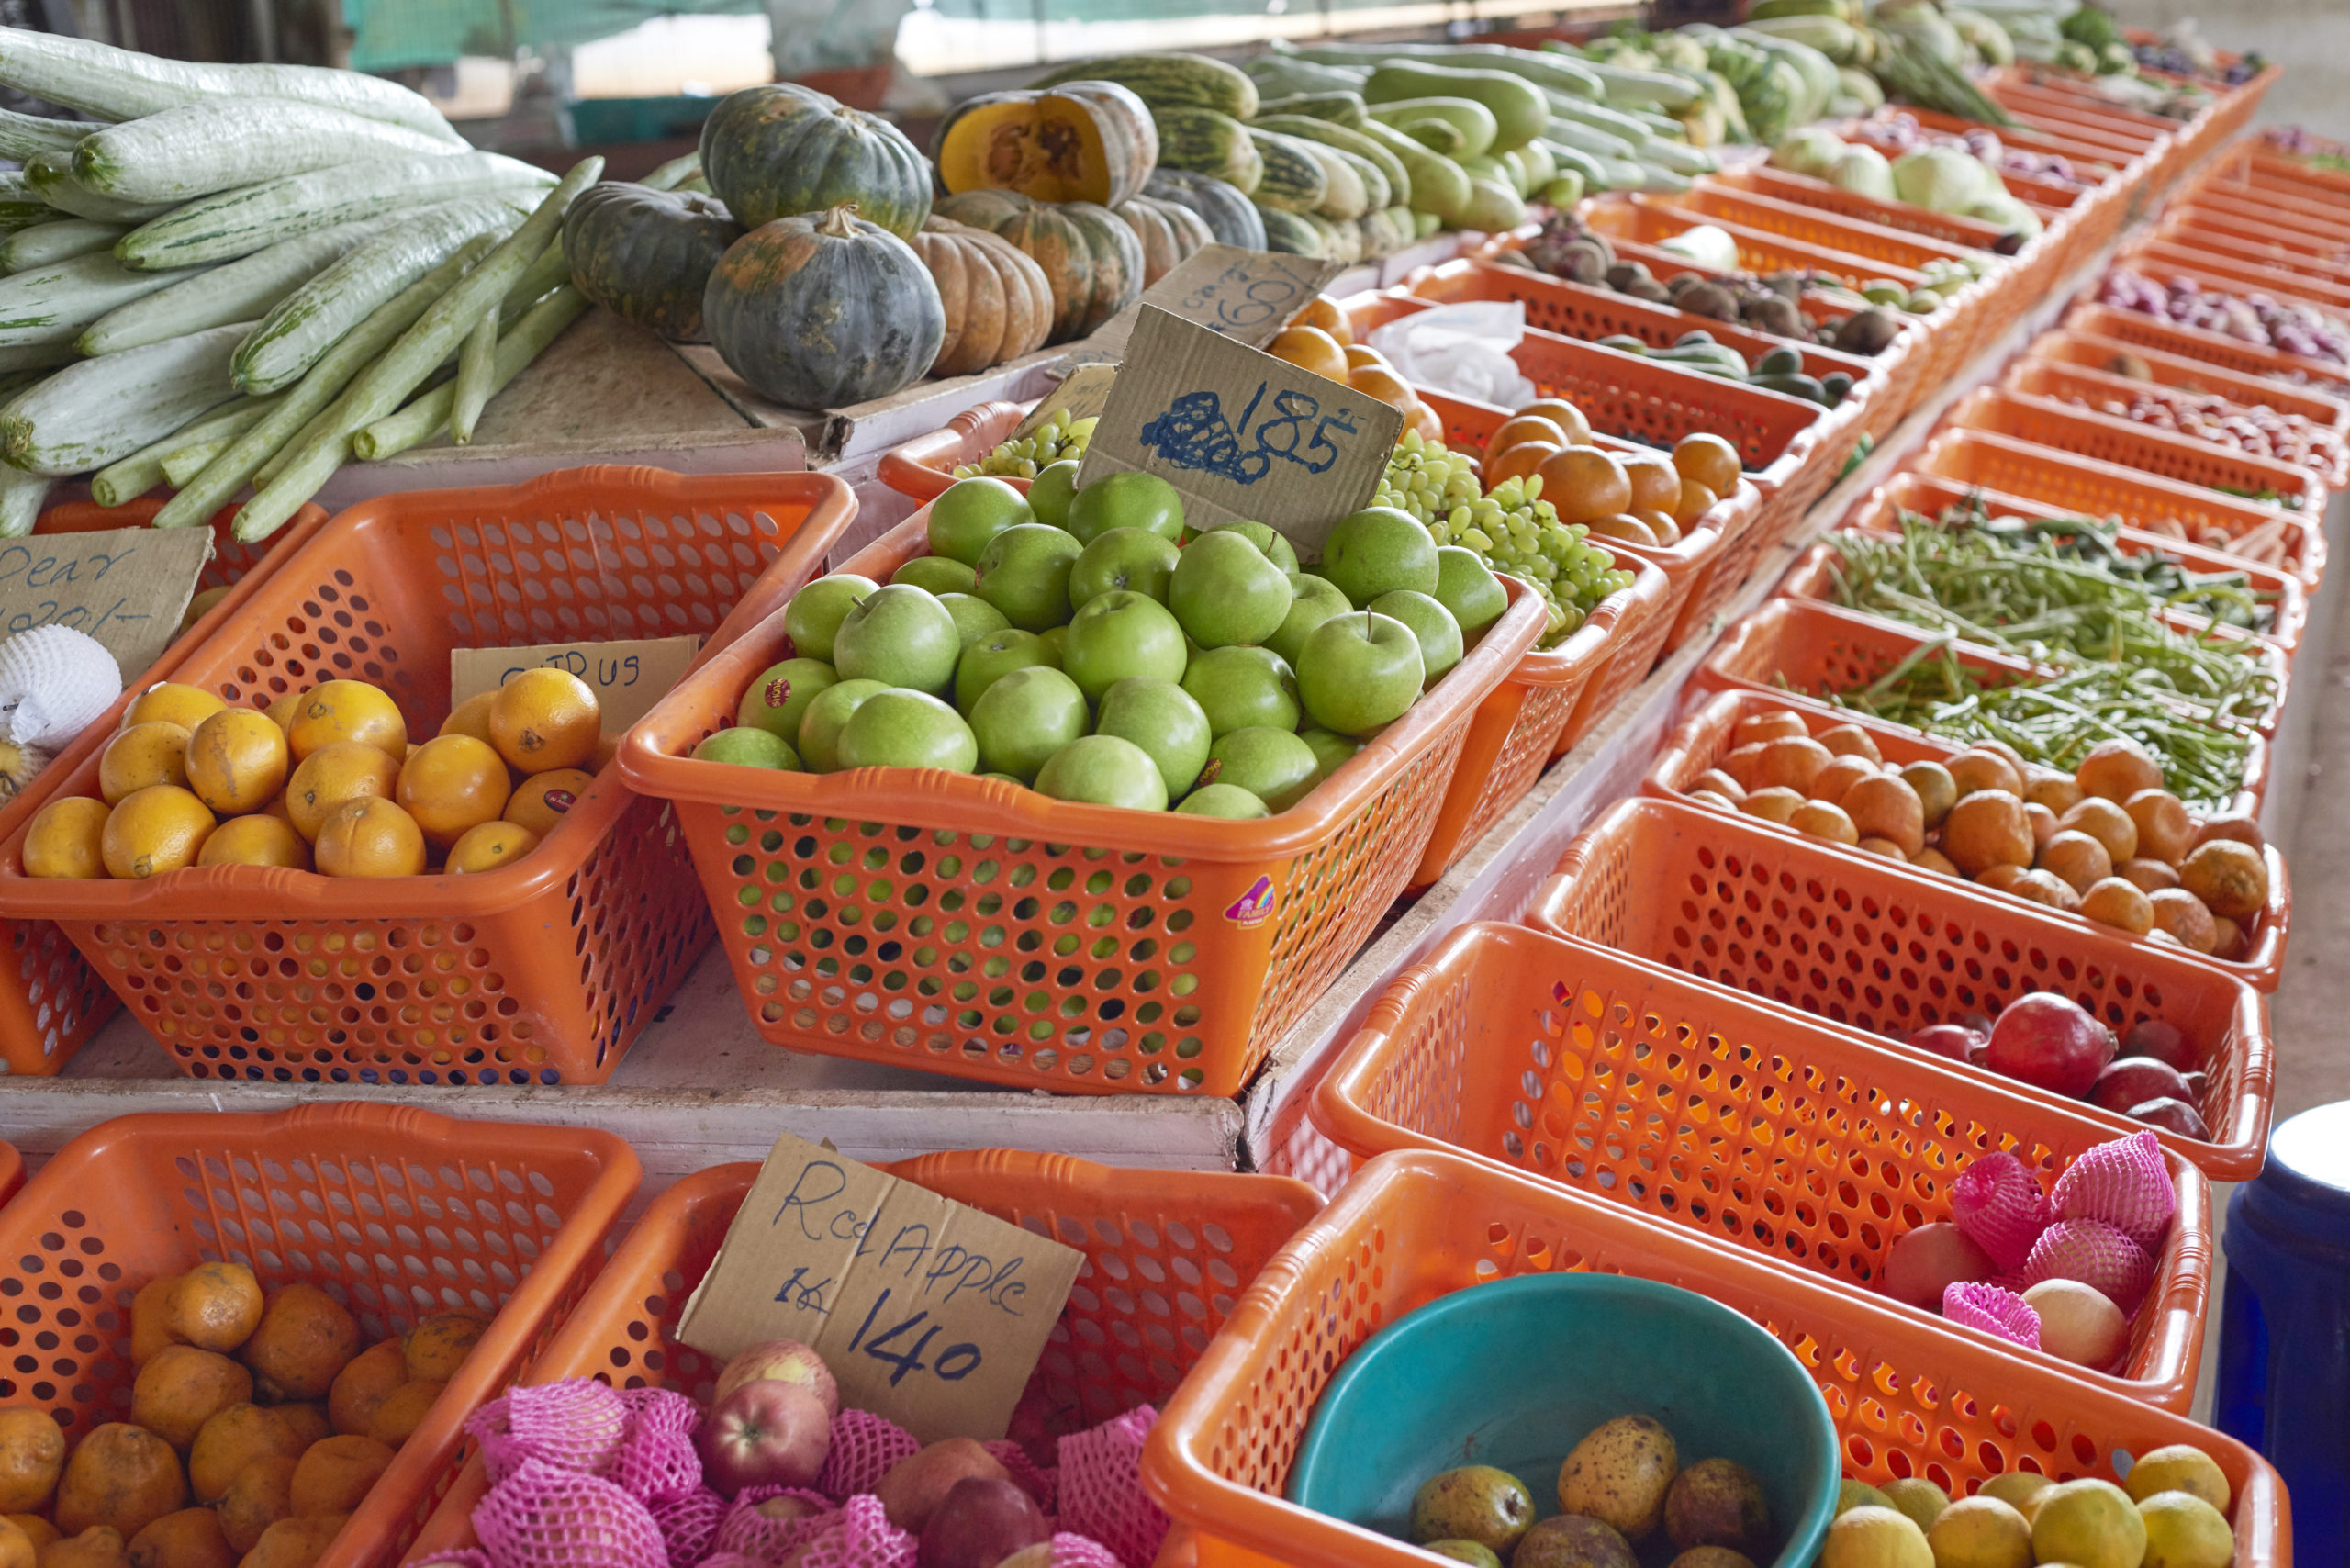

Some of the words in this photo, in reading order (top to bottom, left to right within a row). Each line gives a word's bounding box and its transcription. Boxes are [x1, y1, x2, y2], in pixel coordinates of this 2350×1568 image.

[0, 597, 152, 636] 20/-
[500, 650, 640, 687] CTRUS
[847, 1288, 982, 1387] 140
